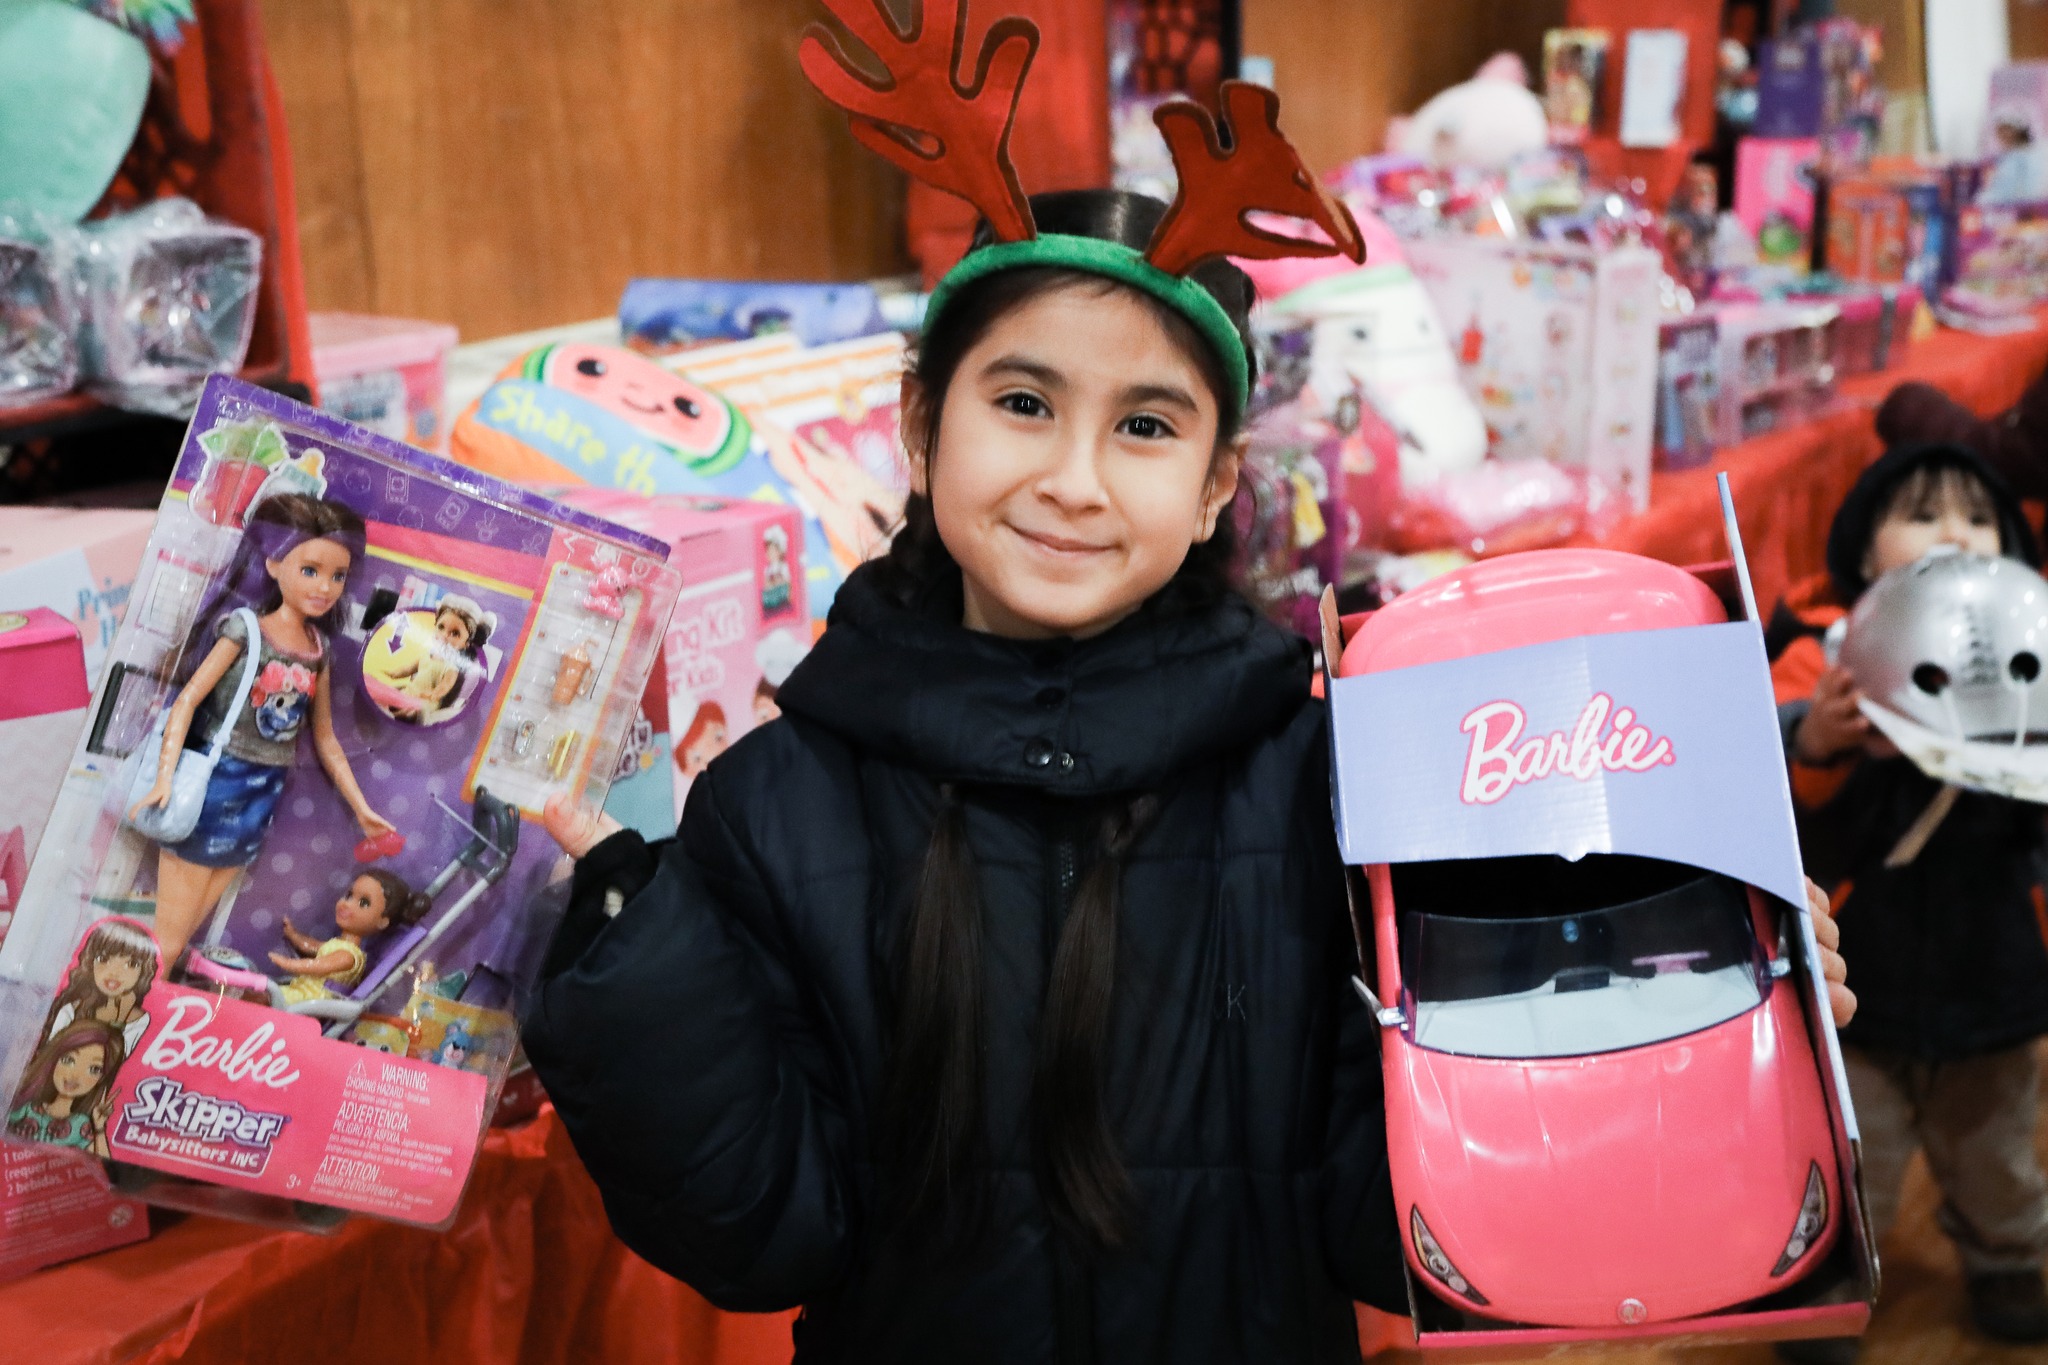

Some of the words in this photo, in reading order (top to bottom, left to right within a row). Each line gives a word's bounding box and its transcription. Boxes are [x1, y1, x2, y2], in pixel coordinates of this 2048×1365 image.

[491, 384, 607, 466] Share
[1461, 692, 1672, 804] Barbie
[141, 995, 300, 1087] Barbie
[126, 1077, 284, 1147] Skipper
[381, 1063, 430, 1091] WARNING:
[124, 1124, 229, 1163] Babysitters
[230, 1150, 261, 1168] INC
[337, 1100, 411, 1132] ADVERTENCIA:
